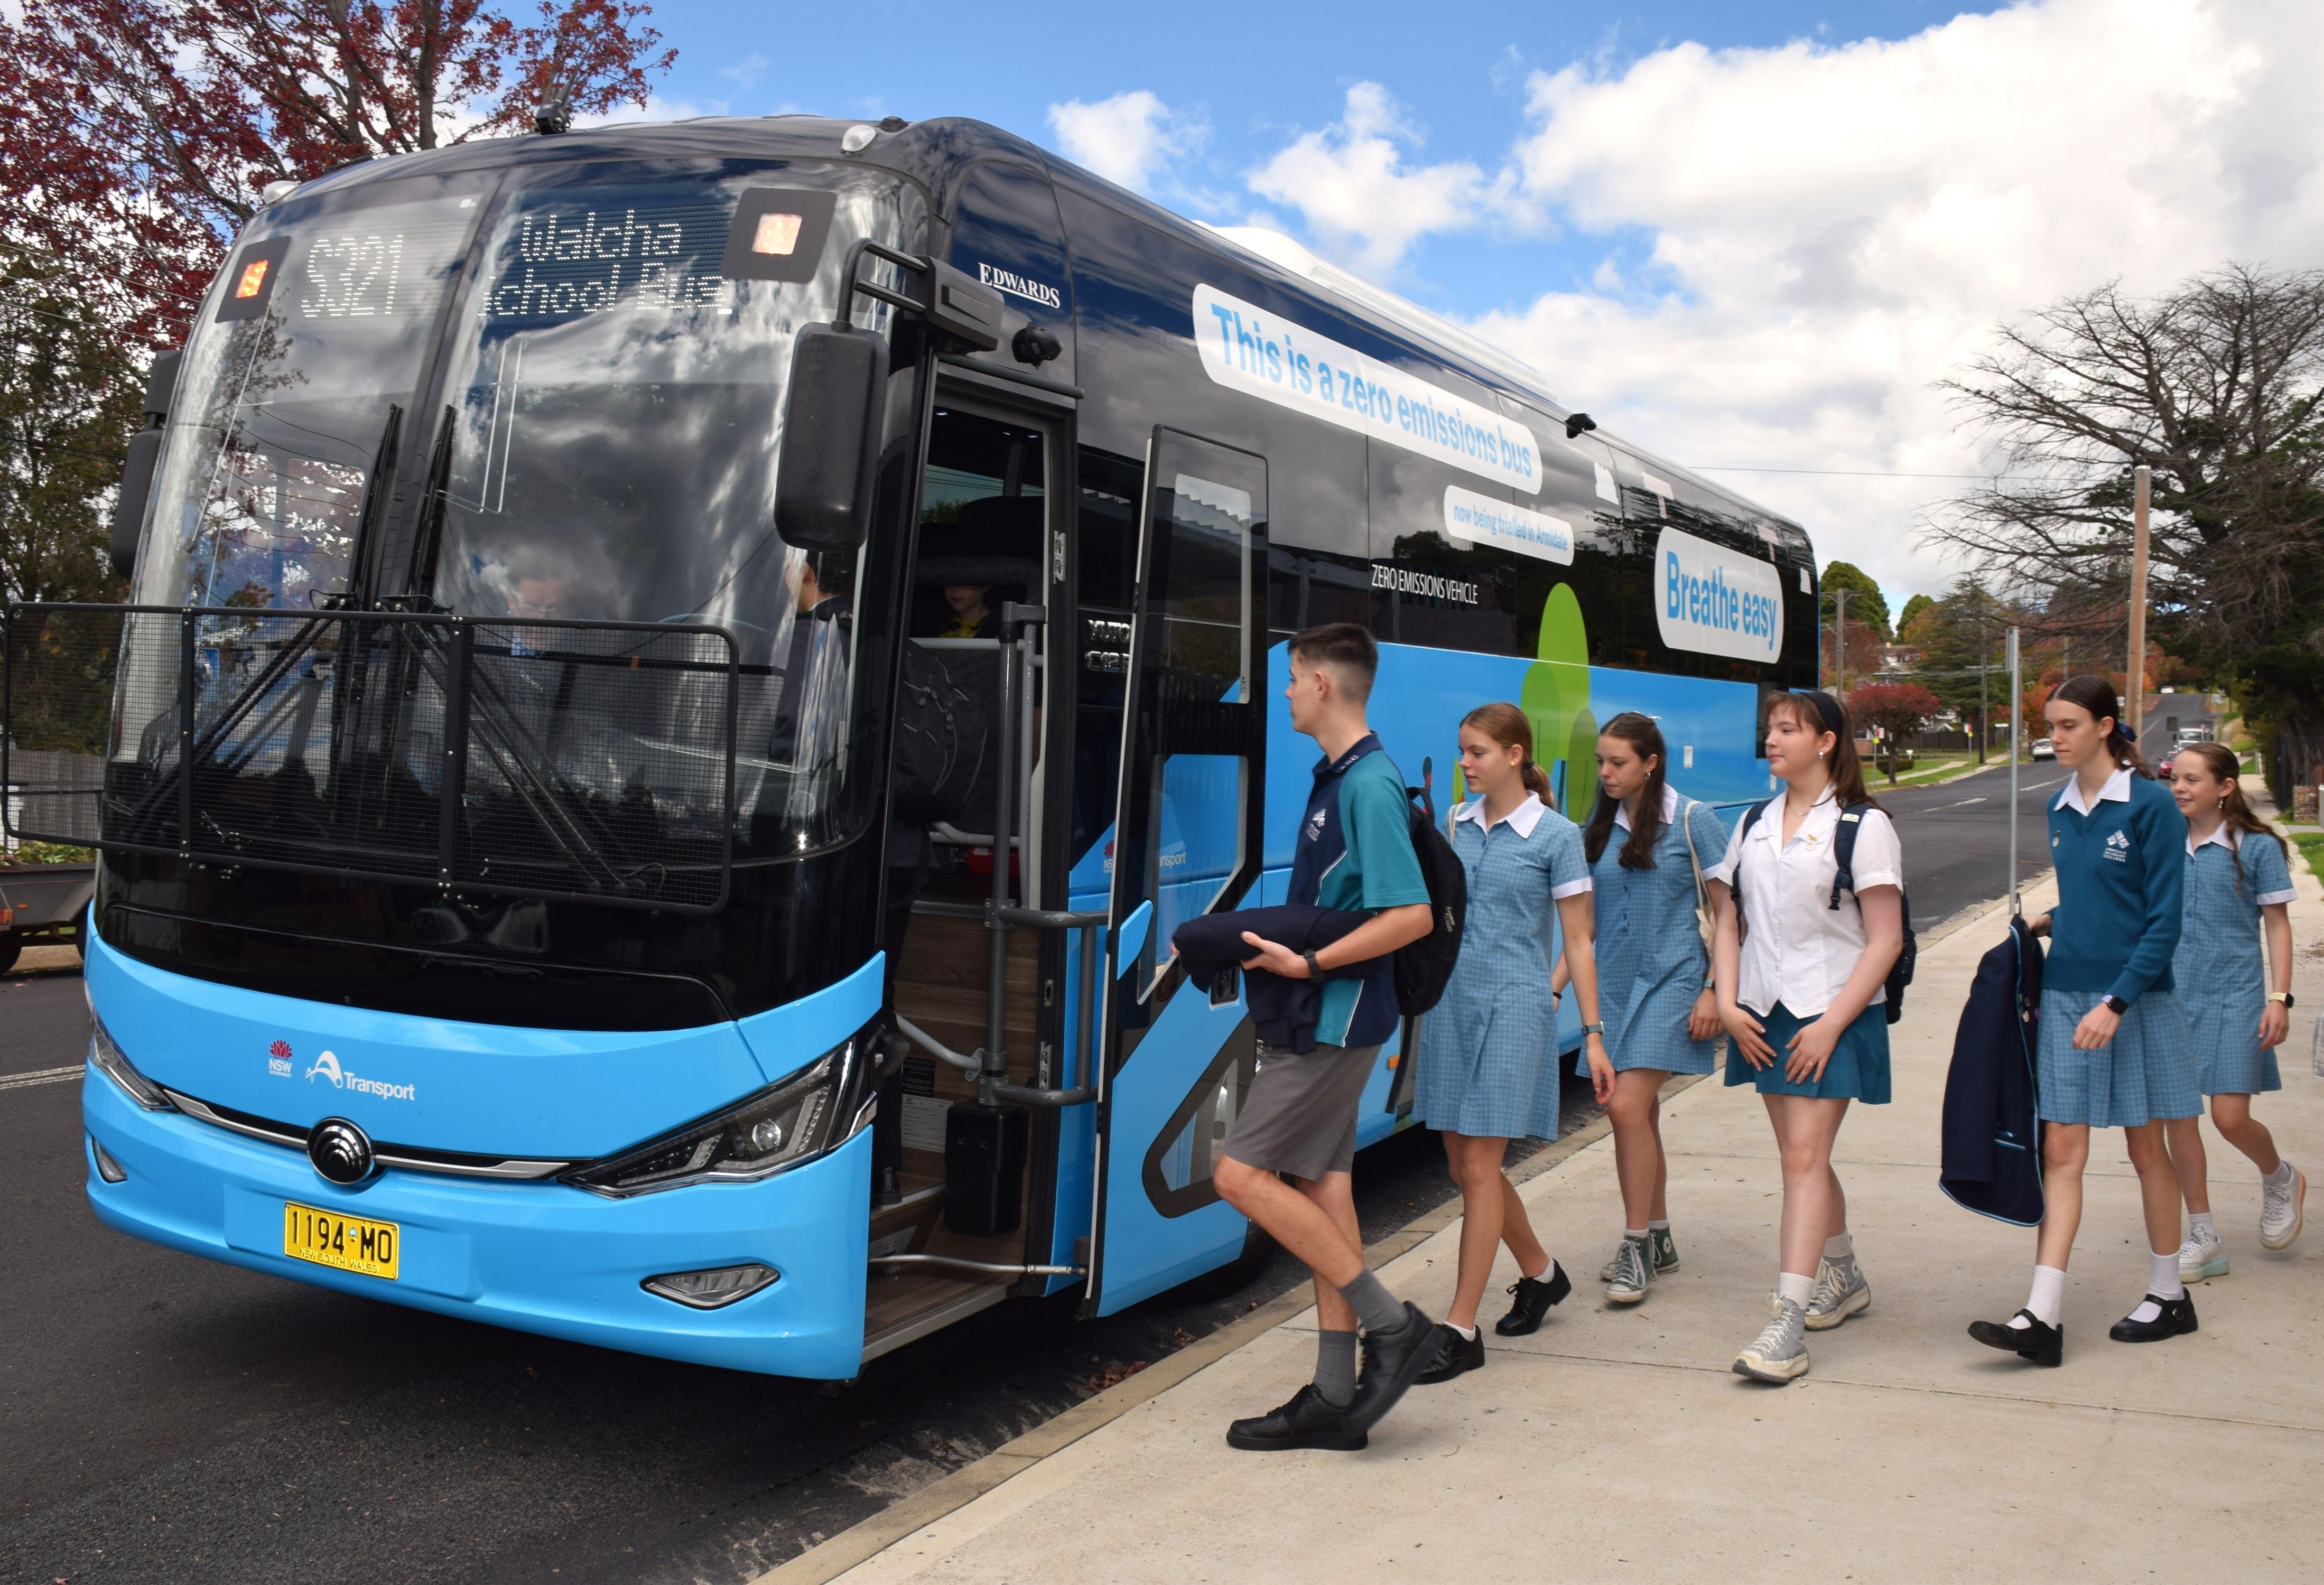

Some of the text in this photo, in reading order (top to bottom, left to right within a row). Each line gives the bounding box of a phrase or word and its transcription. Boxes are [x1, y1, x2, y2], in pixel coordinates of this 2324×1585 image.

[521, 210, 682, 262] Walcha
[301, 235, 403, 317] S321
[637, 263, 729, 310] Bus
[978, 262, 1060, 309] EDWARDS
[1211, 303, 1532, 478] This is a zero emissions bus
[1454, 505, 1568, 552] now being trialled in Armidale
[1371, 564, 1478, 604] ZERO EMISSIONS VEHICLE
[1667, 551, 1777, 651] Breathe easy
[1087, 619, 1130, 643] YUTO
[1104, 851, 1186, 870] NS nsport
[269, 1058, 415, 1101] NSW Transport
[293, 1210, 393, 1264] 1194 MO
[300, 1247, 379, 1273] NEW SOUTH WALES
